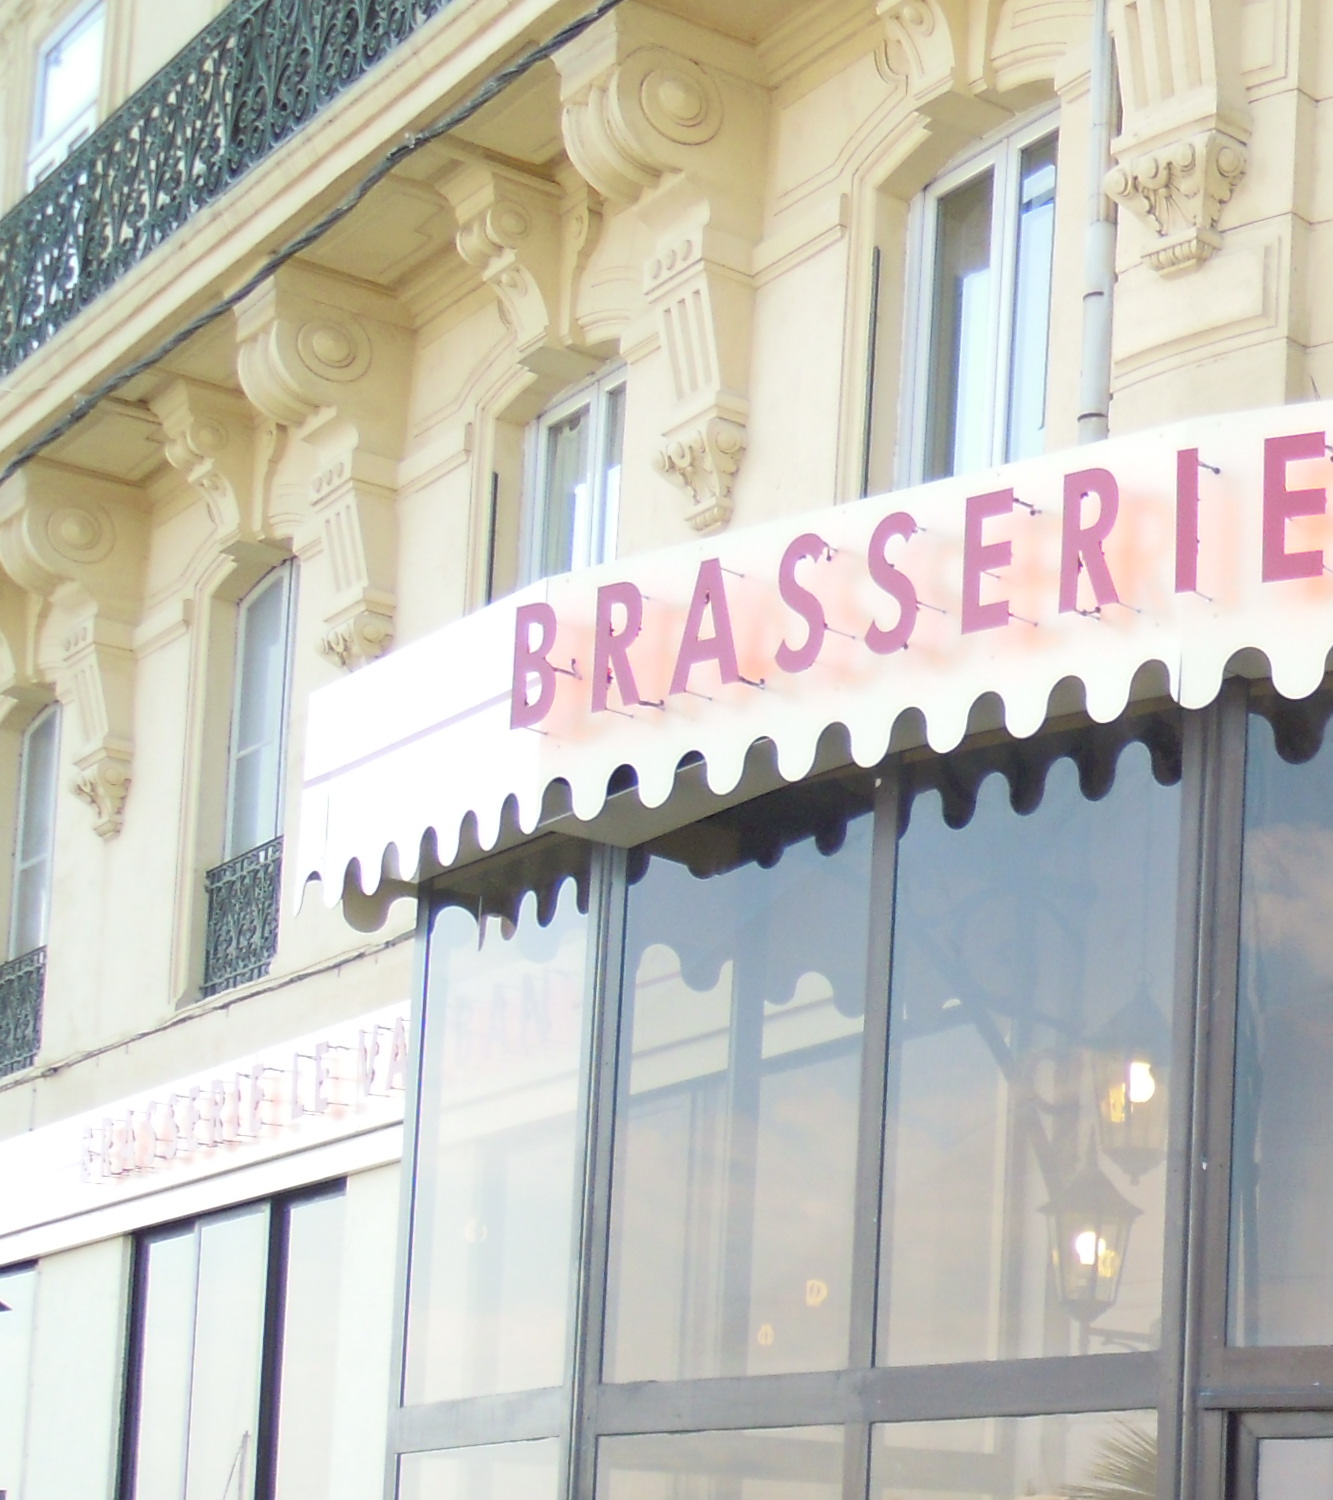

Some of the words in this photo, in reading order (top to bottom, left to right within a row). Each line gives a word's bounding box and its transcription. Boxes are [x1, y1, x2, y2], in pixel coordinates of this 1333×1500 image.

[509, 431, 1327, 730] BRASSERIE
[82, 1063, 266, 1183] BRASSERIE
[292, 1041, 330, 1119] LE
